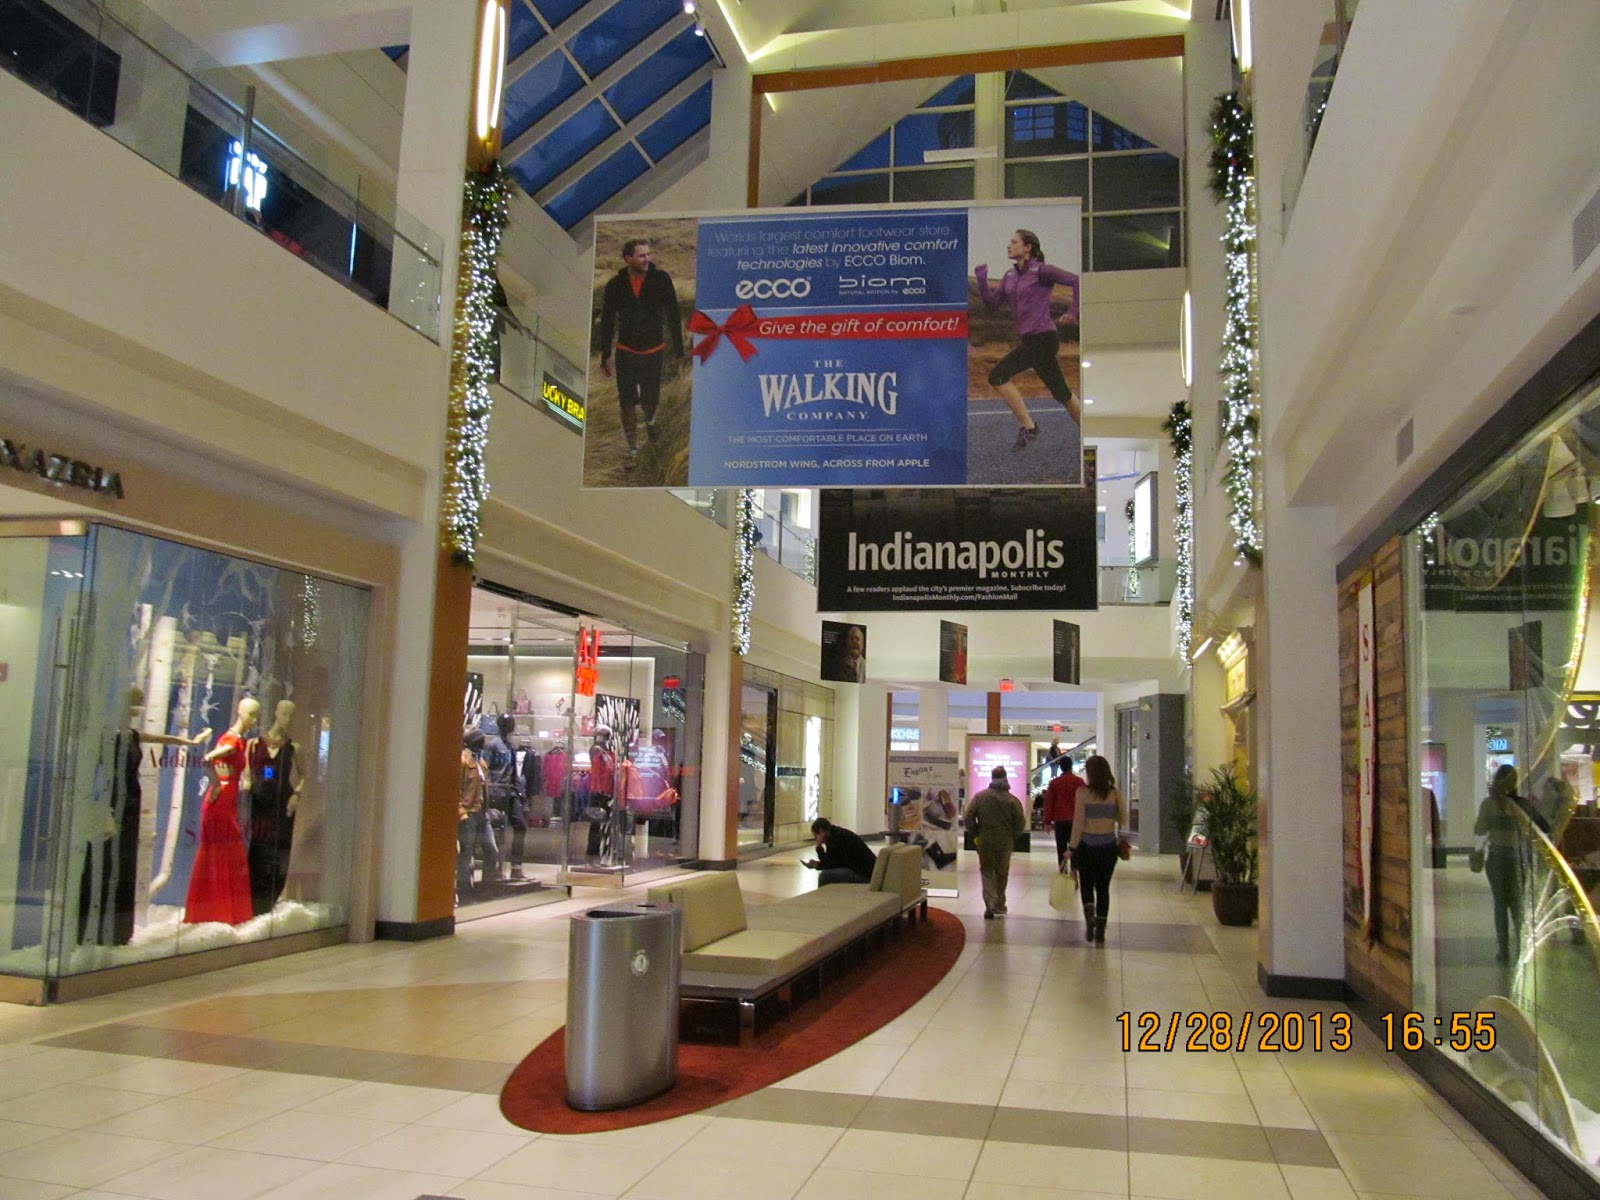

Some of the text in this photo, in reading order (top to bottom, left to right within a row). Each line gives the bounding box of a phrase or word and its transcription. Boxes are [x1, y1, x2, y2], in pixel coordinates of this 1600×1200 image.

[760, 229, 801, 244] largest
[805, 227, 855, 240] comfort
[858, 226, 916, 239] footwear
[707, 238, 959, 259] featuring the latest innovative comfort
[737, 253, 926, 271] technologies by ECCO Biom.
[839, 274, 926, 288] biom
[735, 277, 812, 300] ecco
[902, 287, 926, 295] ecco
[758, 317, 960, 336] Give the gift of comfort!
[813, 359, 844, 368] THE
[758, 371, 899, 418] WALKING
[786, 410, 869, 421] COMPANY
[727, 433, 928, 444] THE MOST COMFORTABLE PLACE ON EARTH
[724, 458, 930, 469] NORDSTROM WING, ACROSS FROM APPLE
[848, 528, 1065, 579] Indianapolis
[991, 570, 1050, 578] MONTHLY
[891, 585, 918, 594] applaud
[930, 585, 948, 594] city's
[948, 585, 975, 593] premier
[976, 585, 1010, 593] magazine.
[1011, 584, 1043, 592] Subscribe
[1044, 584, 1067, 593] today!
[892, 593, 1018, 602] IndianapolisMonthly.com/FashionMall
